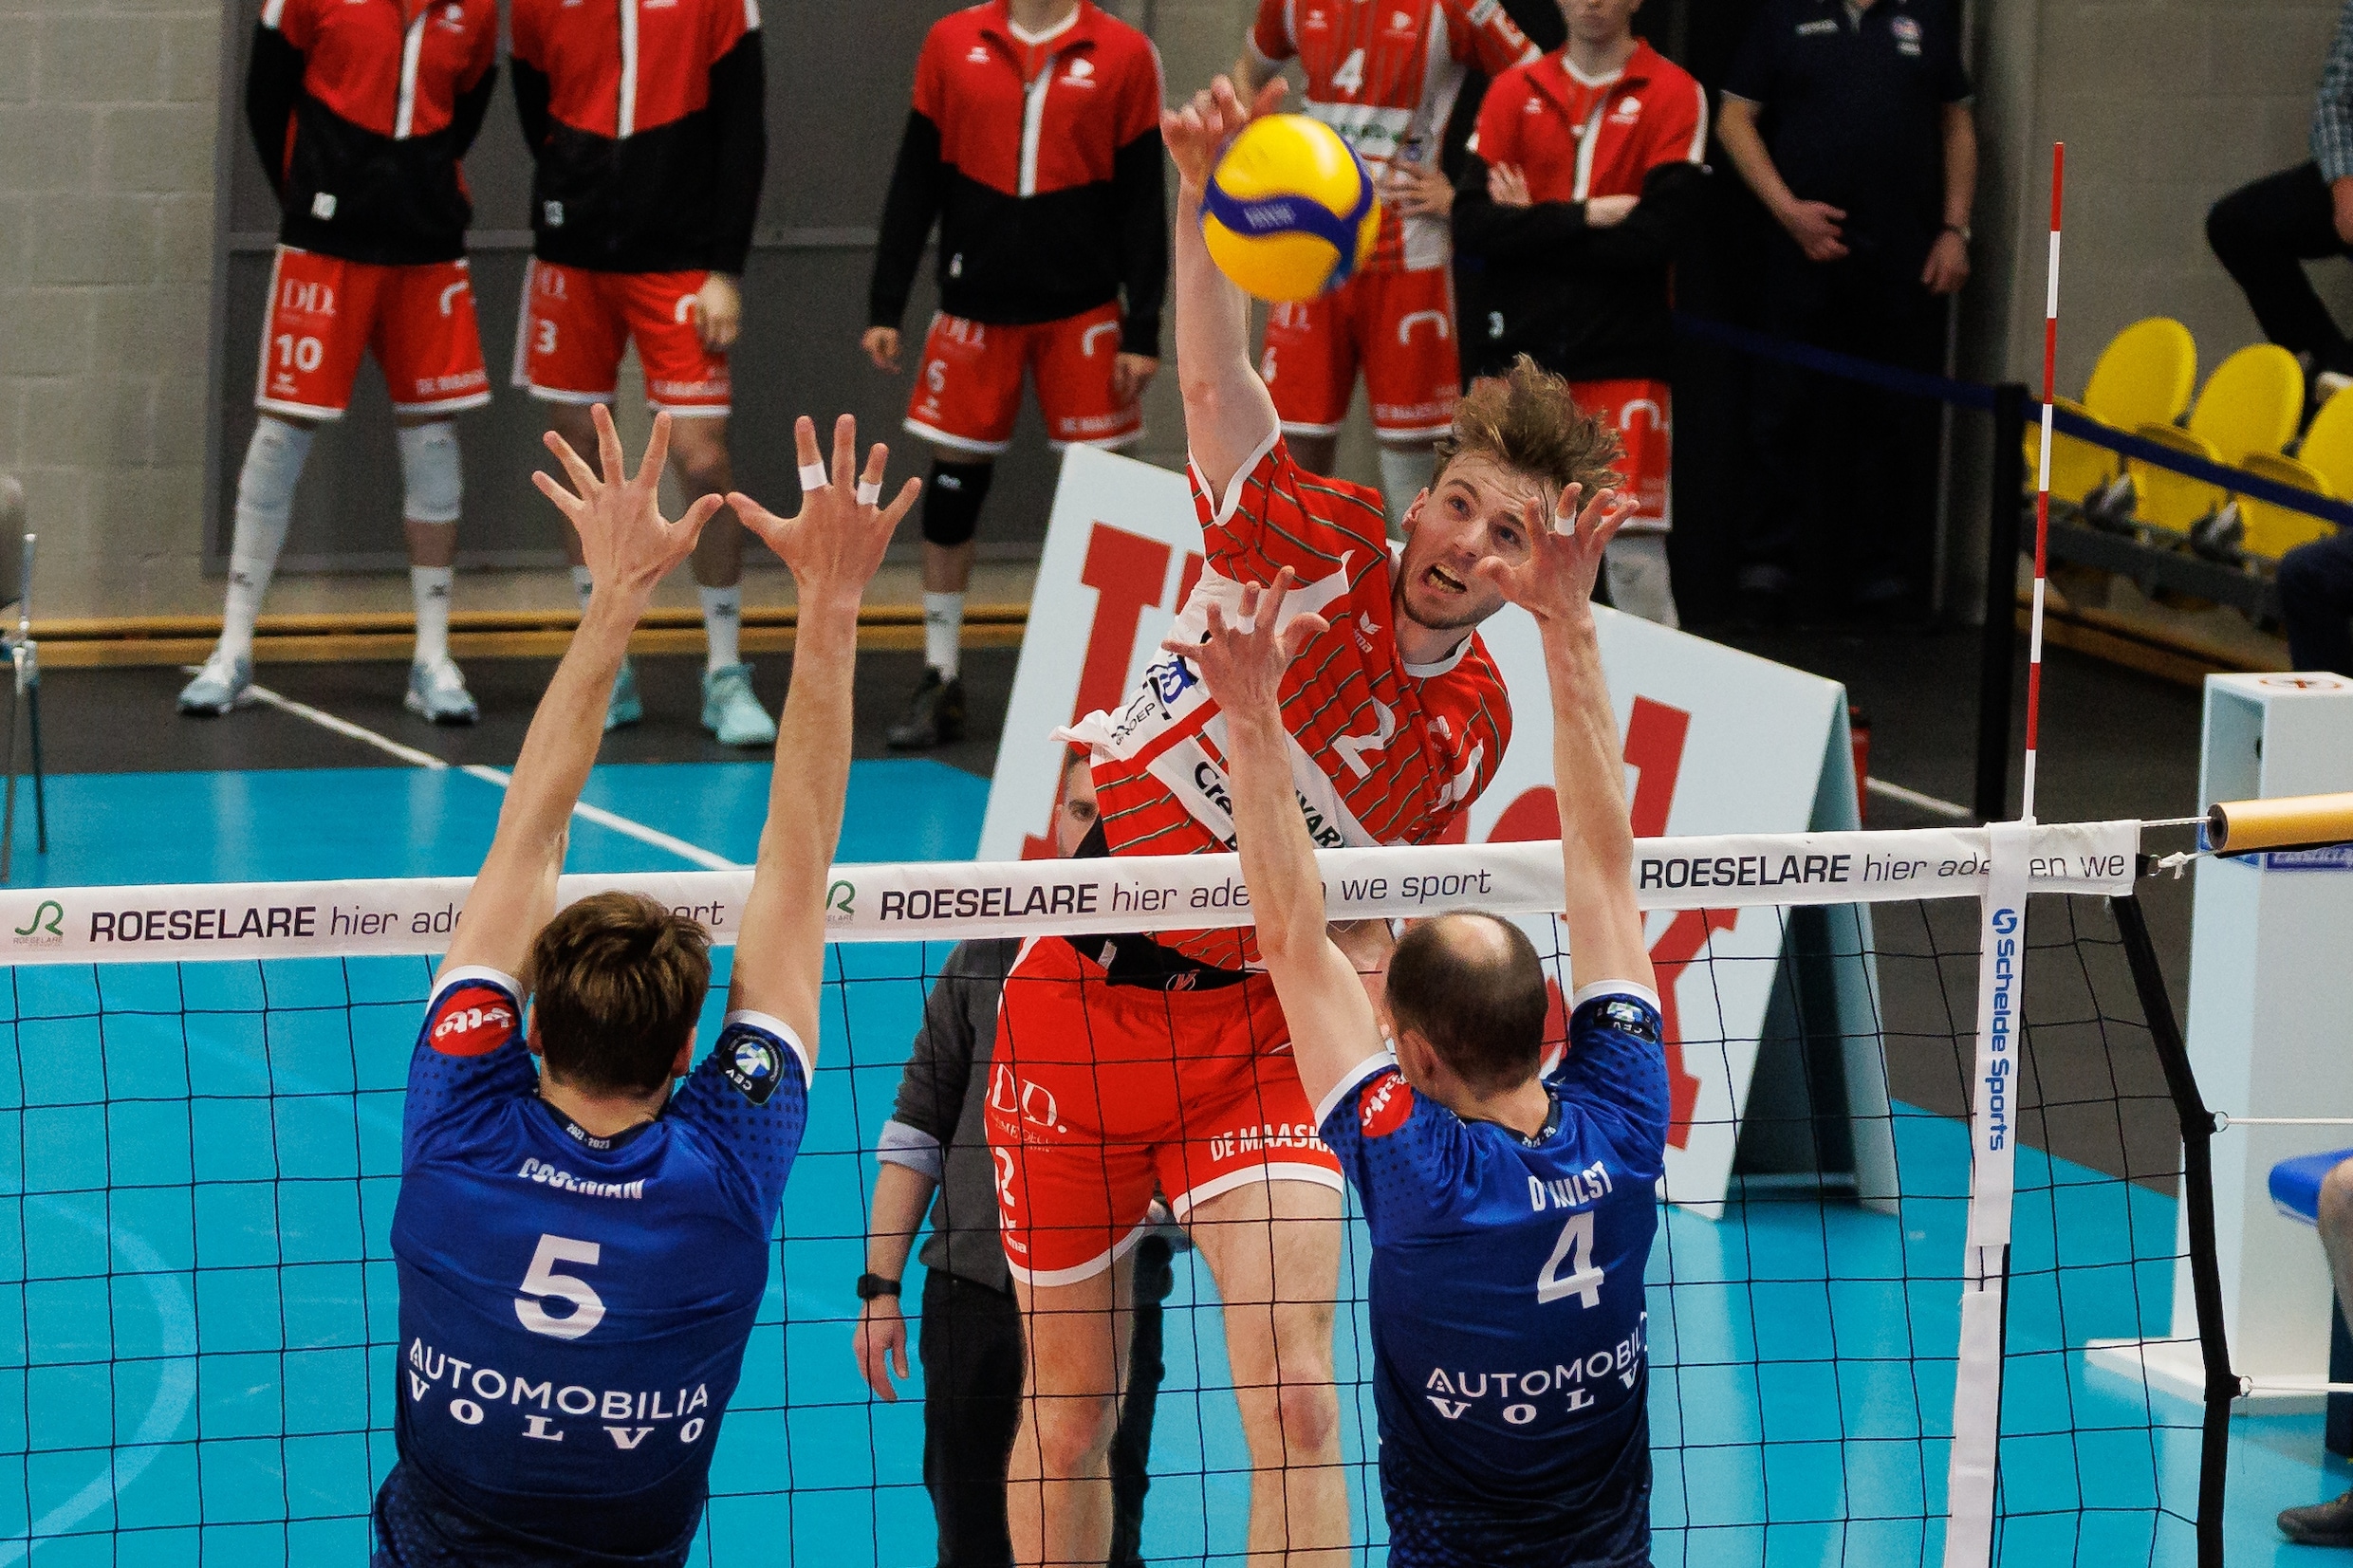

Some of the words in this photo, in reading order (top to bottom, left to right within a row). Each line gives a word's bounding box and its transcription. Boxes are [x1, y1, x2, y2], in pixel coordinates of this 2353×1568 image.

[1331, 48, 1365, 94] 4
[276, 334, 324, 374] 10
[536, 320, 559, 355] 3
[1640, 855, 1851, 889] ROESELARE
[1863, 854, 1928, 881] hier
[1937, 852, 2067, 877] adeen
[2080, 855, 2124, 877] we
[880, 883, 1099, 921] ROESELARE
[1112, 881, 1177, 912] hier
[1342, 877, 1387, 901] we
[1401, 869, 1491, 904] sport
[90, 907, 315, 943] ROESELARE
[330, 905, 398, 936] hier
[1992, 938, 2015, 1052] Schelde
[725, 1068, 752, 1091] CEV
[1985, 1058, 2010, 1151] Sports
[1210, 1131, 1235, 1162] DE
[1537, 1210, 1604, 1309] 4
[513, 1232, 607, 1339] 5
[409, 1337, 709, 1420] AUTOMOBILIA
